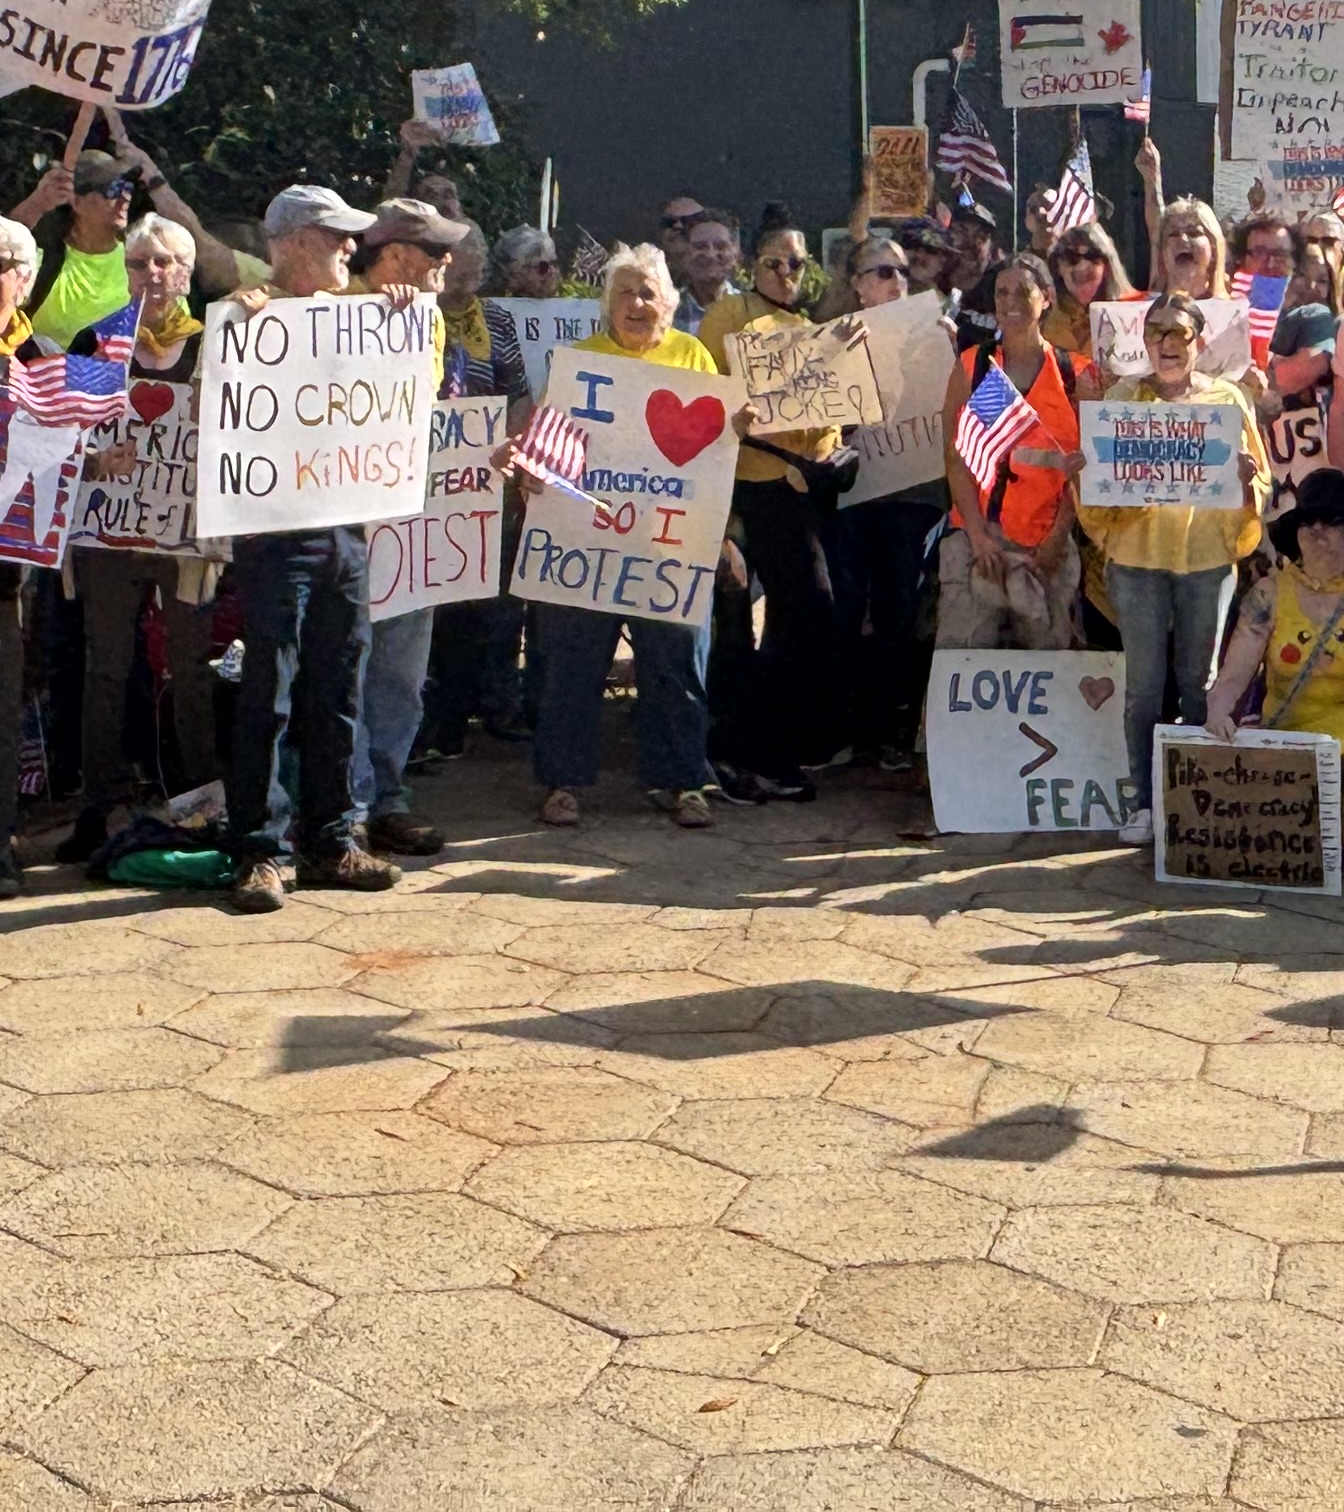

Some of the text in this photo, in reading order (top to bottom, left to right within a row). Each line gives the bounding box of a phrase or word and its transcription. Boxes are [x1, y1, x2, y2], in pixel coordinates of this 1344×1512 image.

[1239, 19, 1334, 41] TYRANT
[1021, 67, 1137, 100] GENOCIDE
[221, 315, 289, 366] NO
[220, 375, 417, 432] NO CROWN
[571, 371, 615, 423] I
[220, 452, 278, 497] NO
[429, 466, 494, 497] FEAR
[583, 467, 683, 498] merica
[83, 488, 151, 536] RULE
[652, 506, 686, 545] I
[368, 511, 499, 605] OTEST
[519, 528, 714, 618] PROTEST
[949, 670, 1054, 714] LOVE
